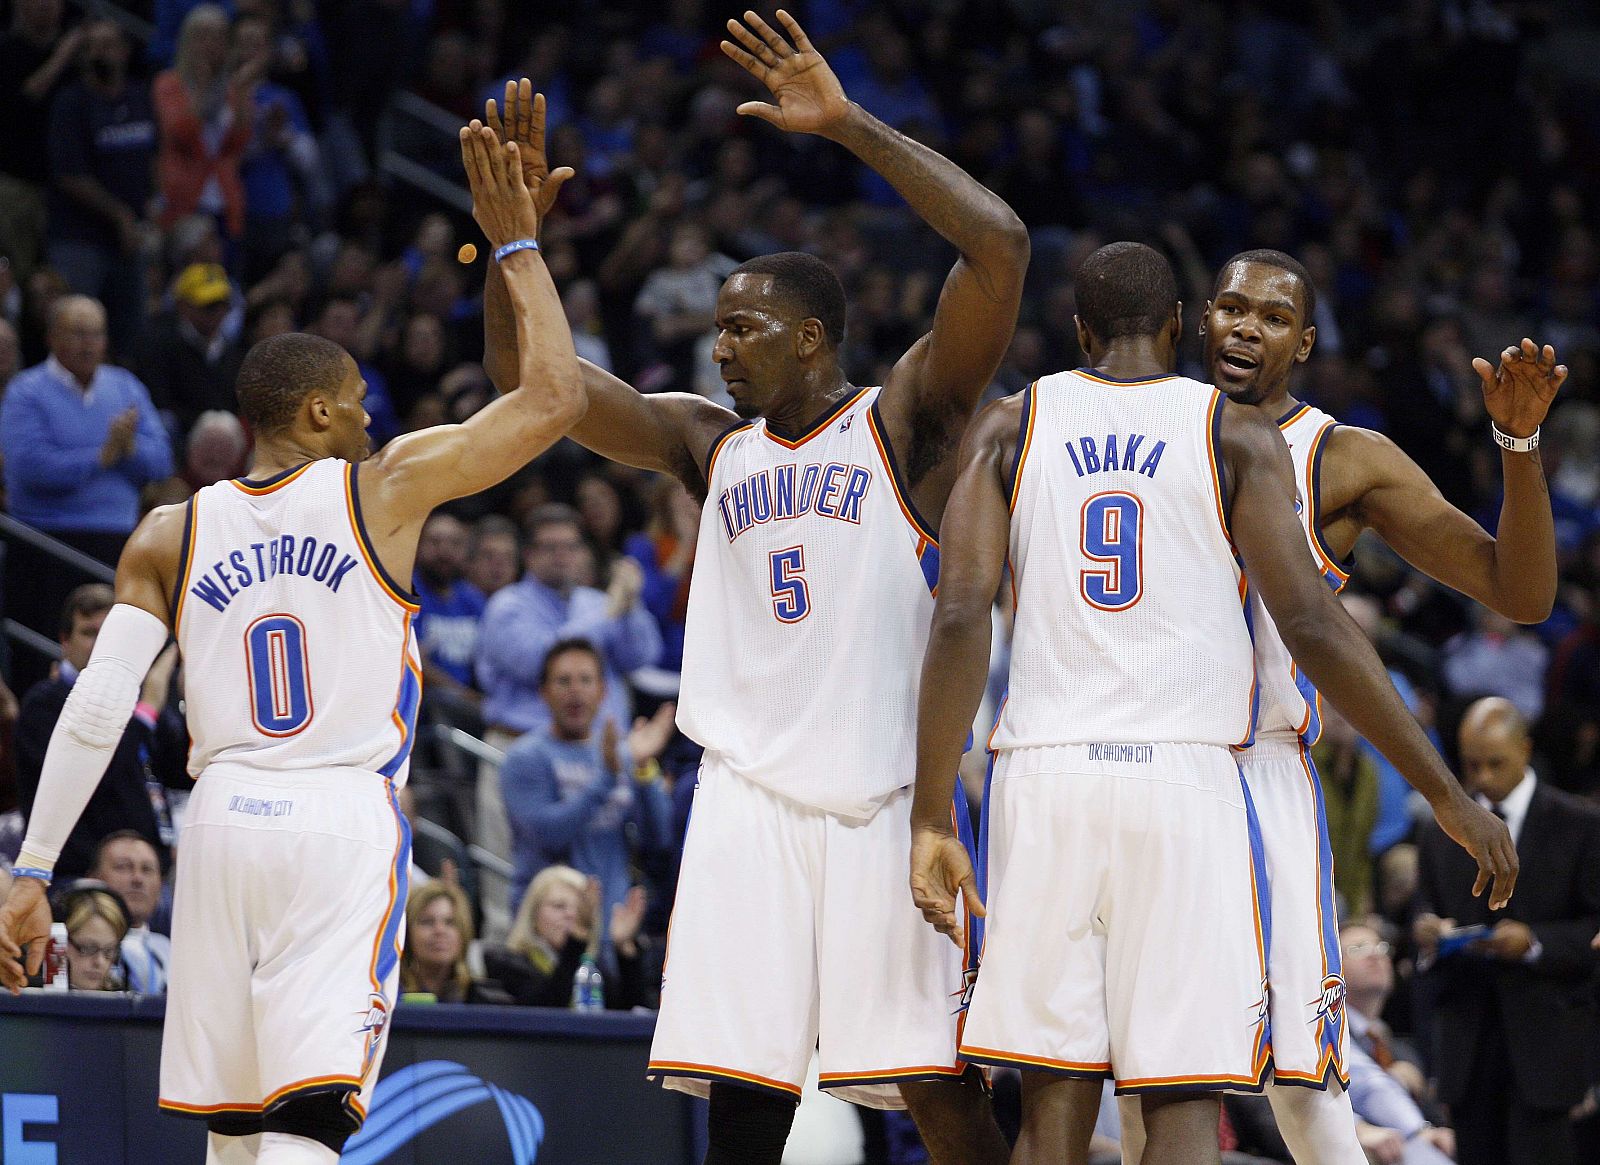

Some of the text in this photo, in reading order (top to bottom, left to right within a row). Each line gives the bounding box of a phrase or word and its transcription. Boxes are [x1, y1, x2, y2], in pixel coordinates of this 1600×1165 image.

[1065, 433, 1167, 479] IBAKA
[718, 462, 873, 544] THUNDER
[191, 534, 359, 613] WESTBROOK
[768, 544, 811, 624] 5
[1079, 490, 1145, 613] 9
[244, 612, 315, 739] 0
[1088, 743, 1153, 764] OKLAHOMA CITY
